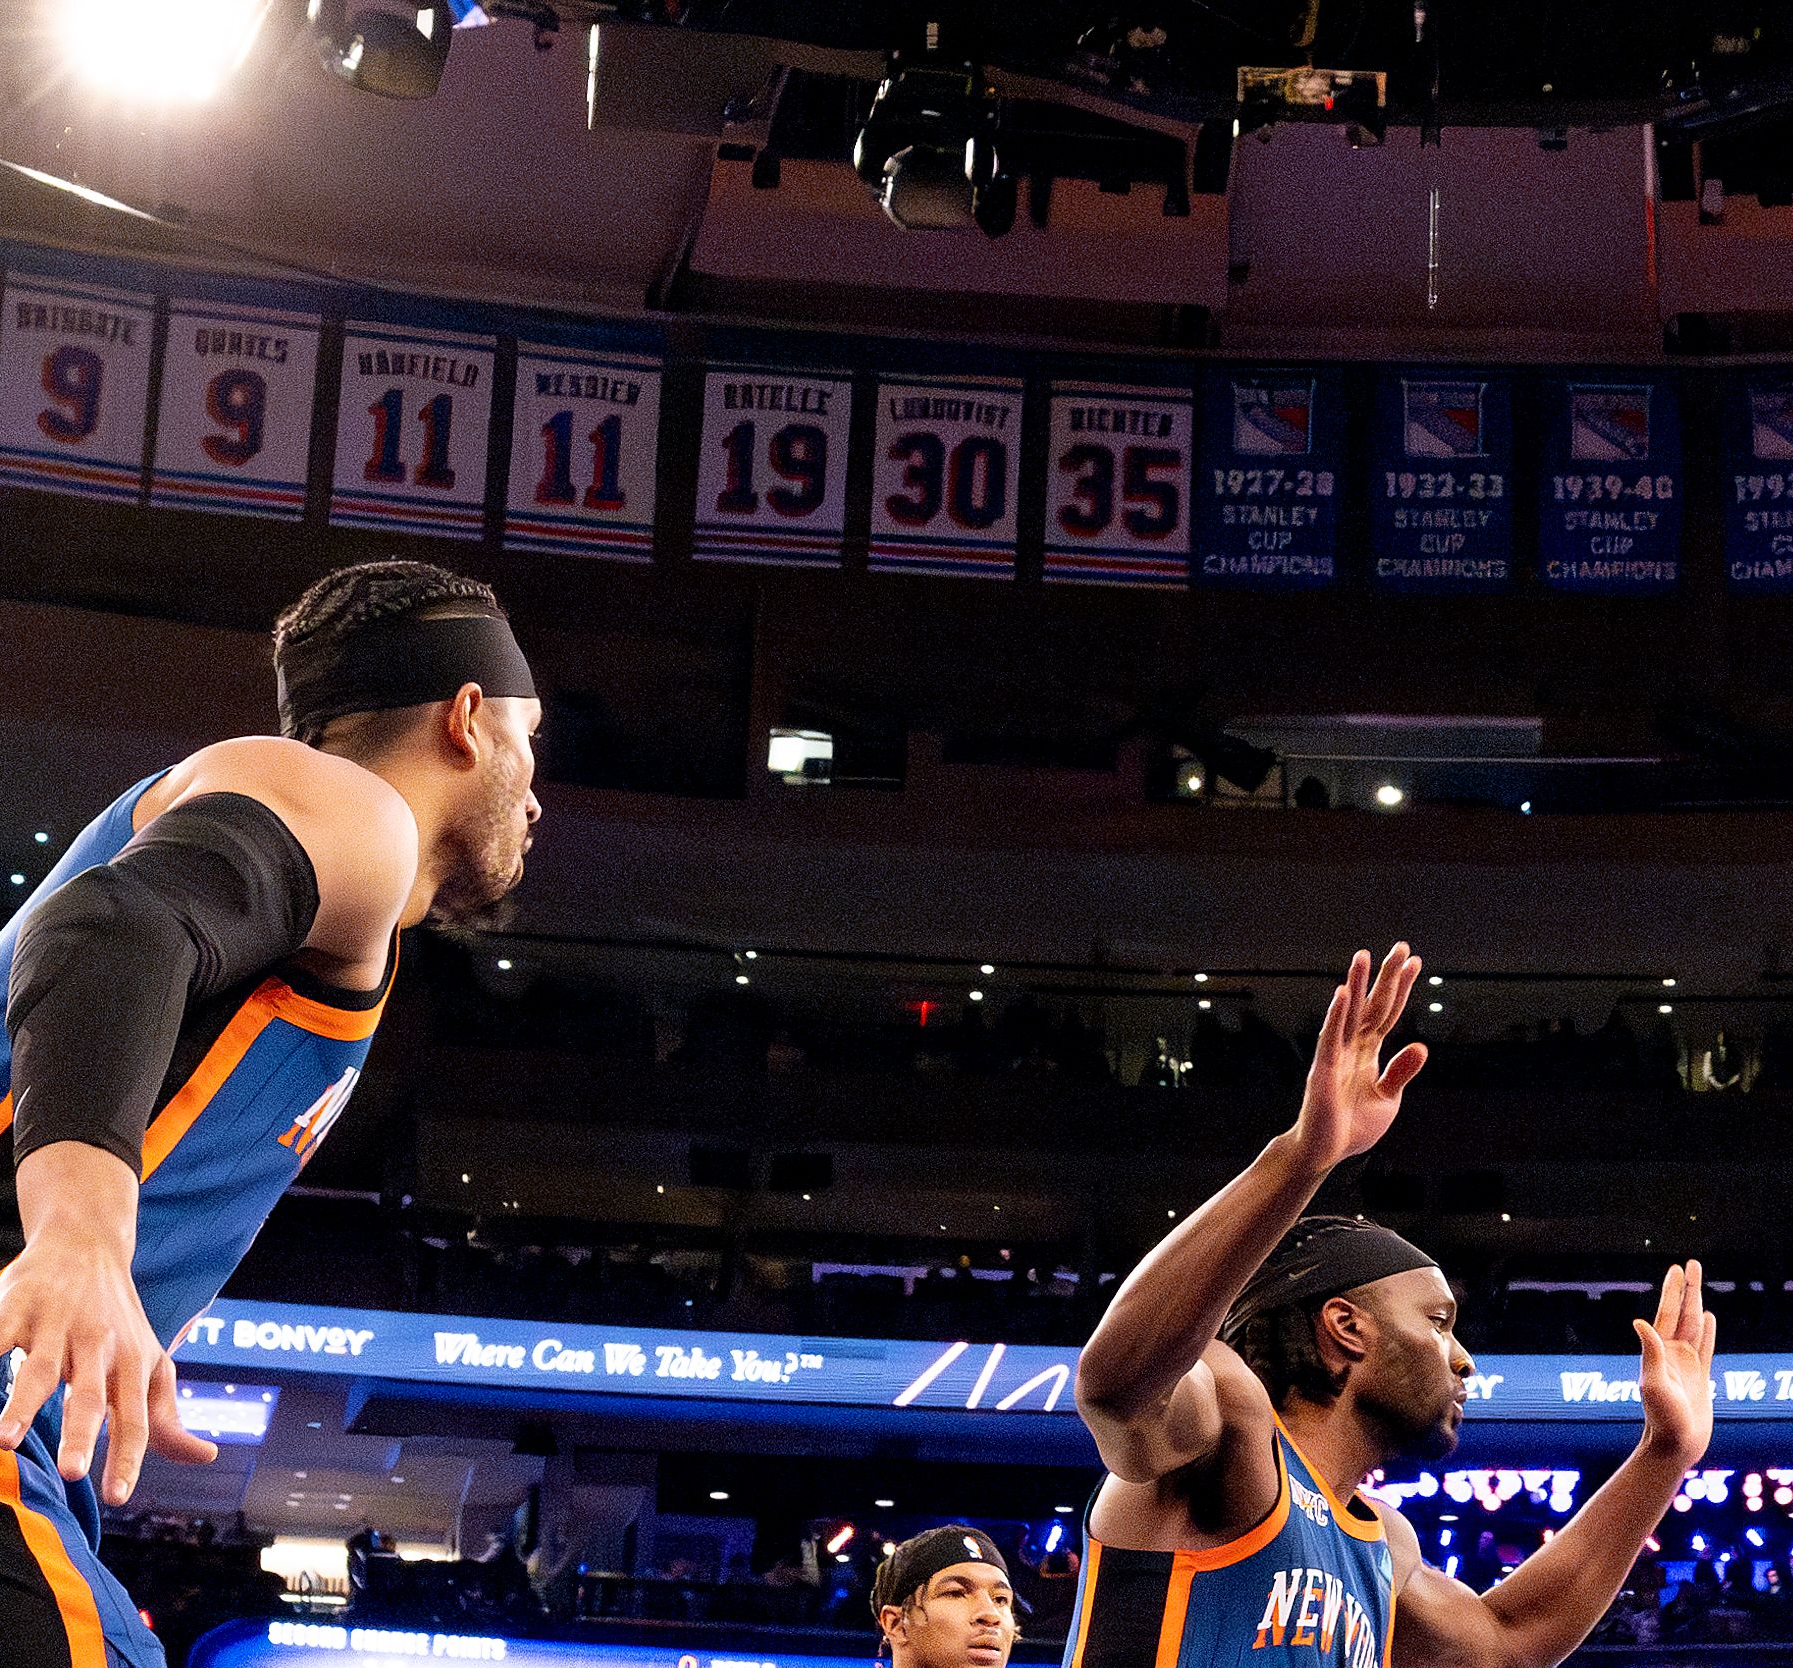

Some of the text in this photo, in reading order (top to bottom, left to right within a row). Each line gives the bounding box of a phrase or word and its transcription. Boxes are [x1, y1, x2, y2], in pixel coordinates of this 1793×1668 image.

[37, 345, 103, 445] 9
[201, 369, 267, 466] 9
[364, 388, 455, 490] 11
[535, 411, 625, 510] 11
[716, 420, 828, 518] 19
[885, 432, 1007, 530] 30
[1058, 443, 1182, 540] 35
[1213, 469, 1334, 498] 1927-28
[1222, 505, 1319, 526] STANLEY
[1564, 509, 1660, 531] STANLEY
[1248, 530, 1293, 551] CUP
[1419, 532, 1467, 554] CUP
[1590, 535, 1635, 556] CUP
[1546, 560, 1677, 581] CHAMPIONS
[233, 1319, 374, 1356] BONVOY
[434, 1331, 524, 1369] Where
[532, 1338, 595, 1373] Can
[603, 1342, 646, 1377] We
[655, 1345, 723, 1380] Take
[1723, 1370, 1765, 1402] We
[1253, 1567, 1345, 1654] NEW
[432, 1633, 507, 1661] POINTS
